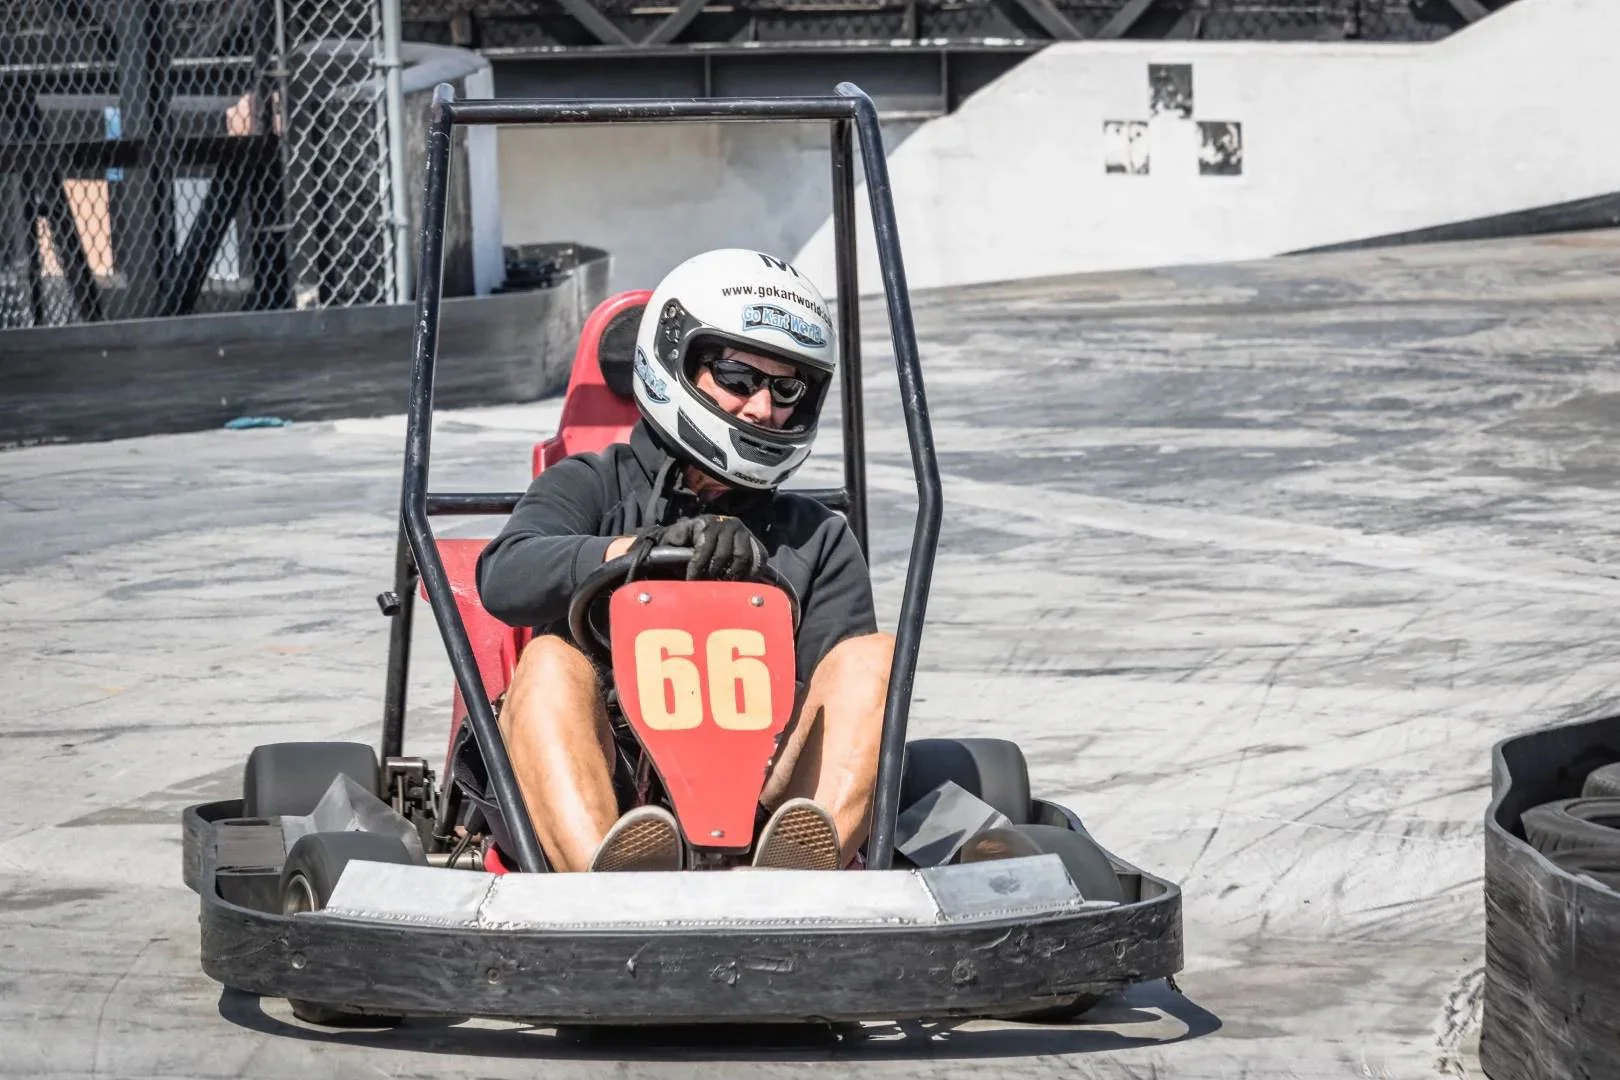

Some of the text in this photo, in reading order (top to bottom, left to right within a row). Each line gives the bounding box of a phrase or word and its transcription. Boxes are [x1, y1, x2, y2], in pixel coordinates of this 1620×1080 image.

[743, 307, 761, 322] Go
[762, 308, 790, 329] Kart
[635, 628, 773, 731] 66
